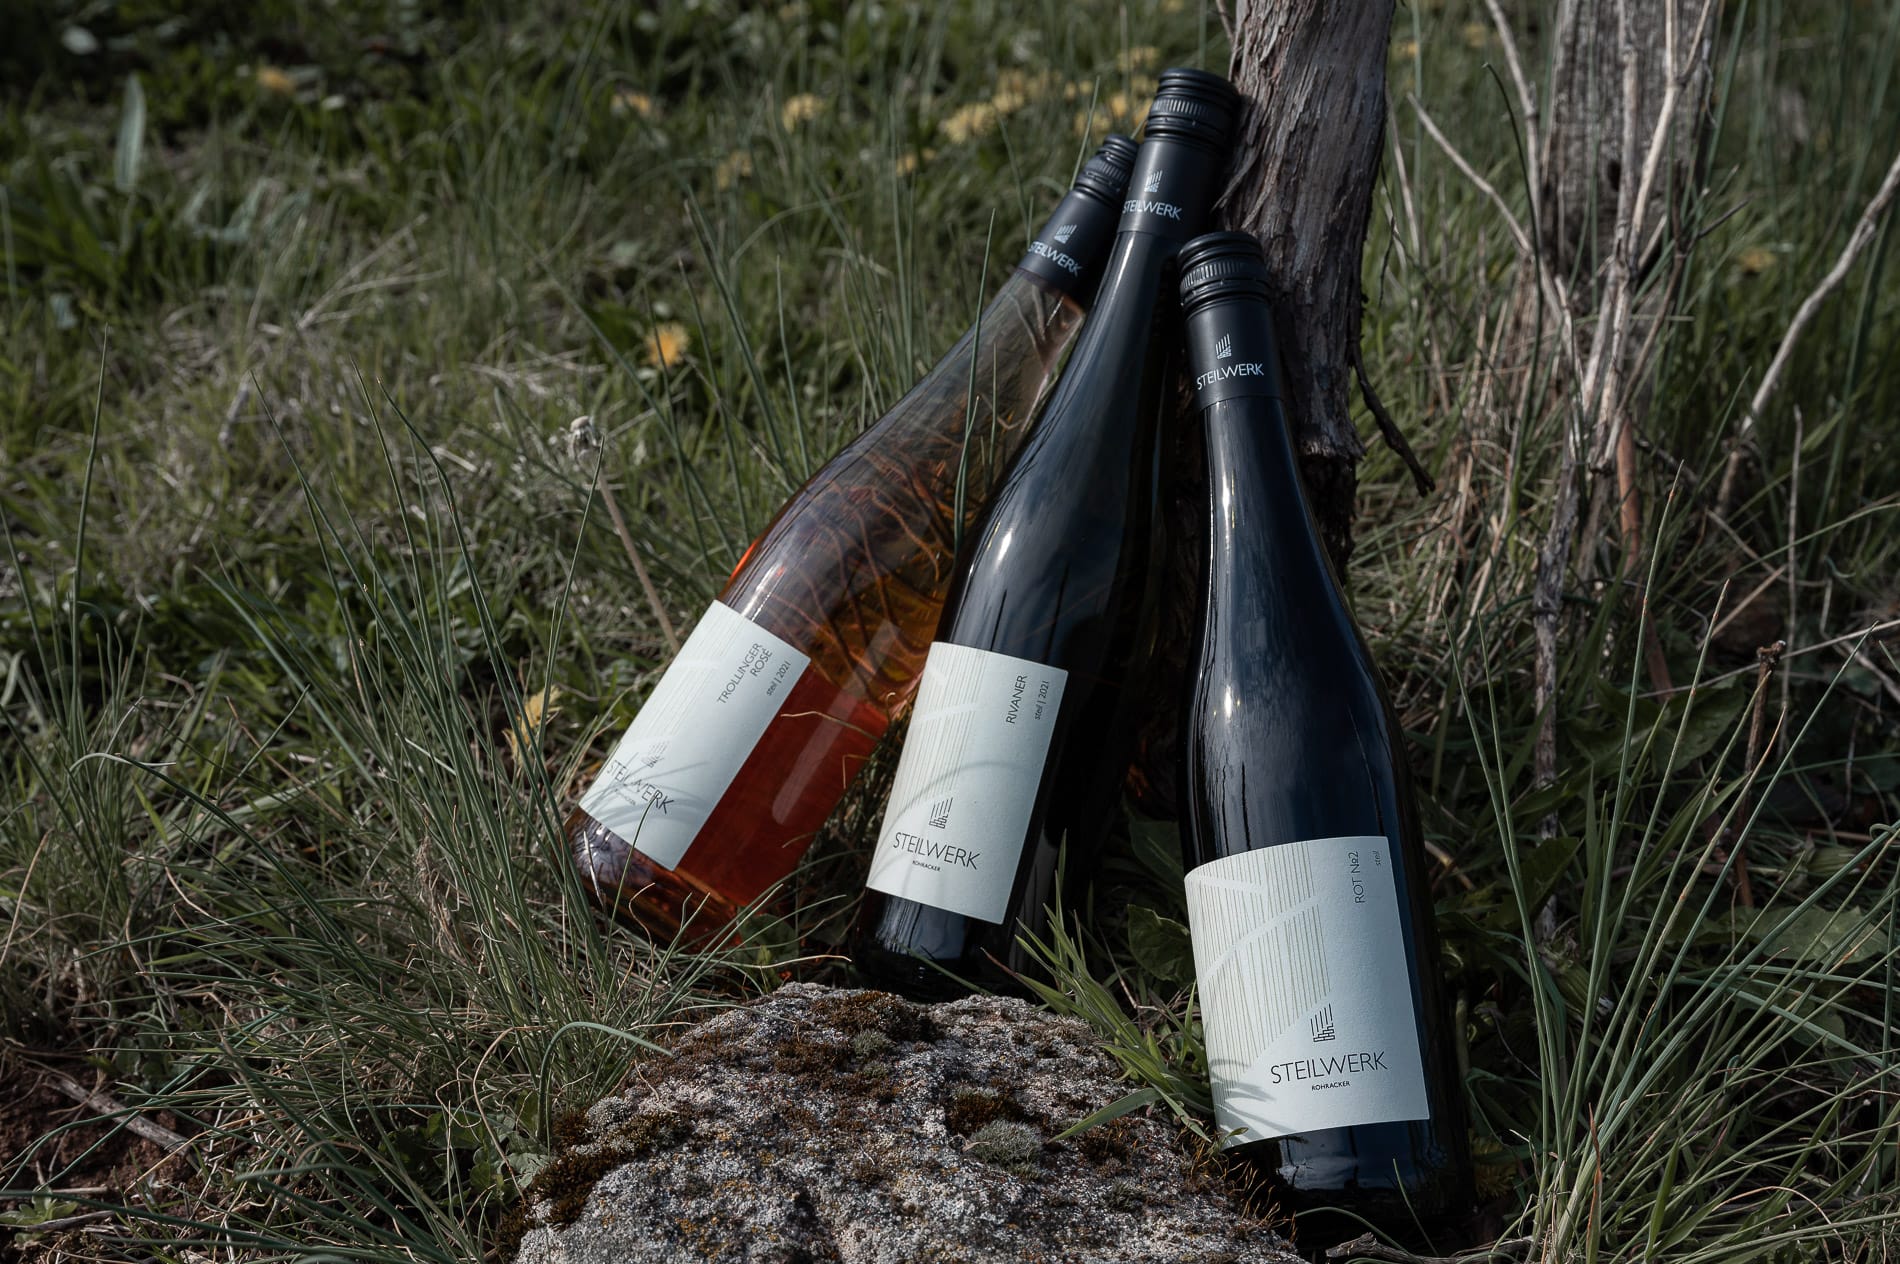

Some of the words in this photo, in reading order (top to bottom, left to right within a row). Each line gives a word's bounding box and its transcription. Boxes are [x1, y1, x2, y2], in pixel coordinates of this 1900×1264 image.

[1122, 199, 1183, 221] STEILWERK
[1027, 241, 1083, 277] STEILWERK
[1196, 363, 1265, 390] STEILWERK
[717, 643, 762, 703] TROLLINGER
[776, 660, 791, 679] 2021
[1005, 675, 1028, 724] RIVANER
[1038, 680, 1050, 699] 2021
[893, 831, 981, 871] STEILWERK
[912, 860, 941, 871] ROHRACKER
[1352, 876, 1366, 904] ROT
[1270, 1050, 1389, 1084] STEILWERK
[1311, 1080, 1351, 1091] ROHRACKER
